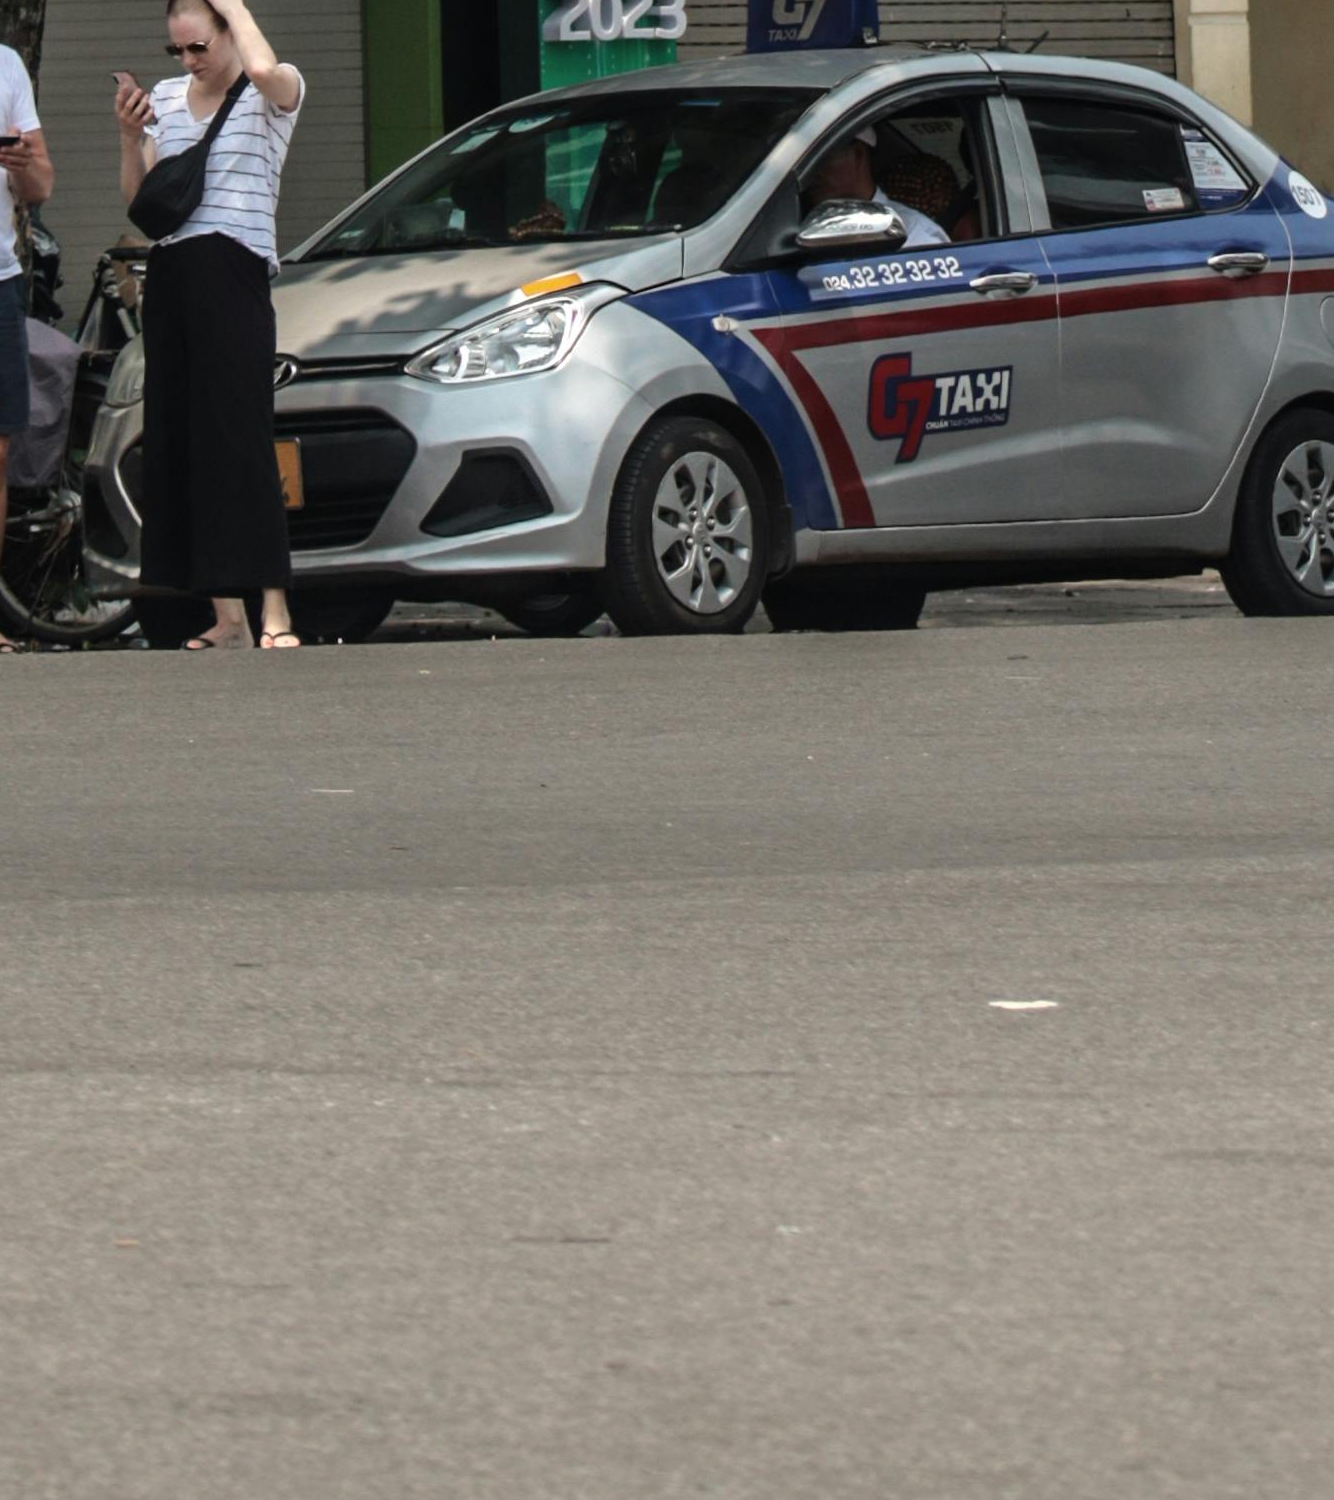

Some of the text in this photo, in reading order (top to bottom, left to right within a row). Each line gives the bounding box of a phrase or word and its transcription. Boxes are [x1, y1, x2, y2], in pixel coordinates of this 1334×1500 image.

[768, 28, 798, 42] TAXI
[878, 263, 907, 285] 32
[906, 259, 935, 282] 32
[933, 256, 963, 278] 32
[869, 353, 1010, 464] G7 TAXI
